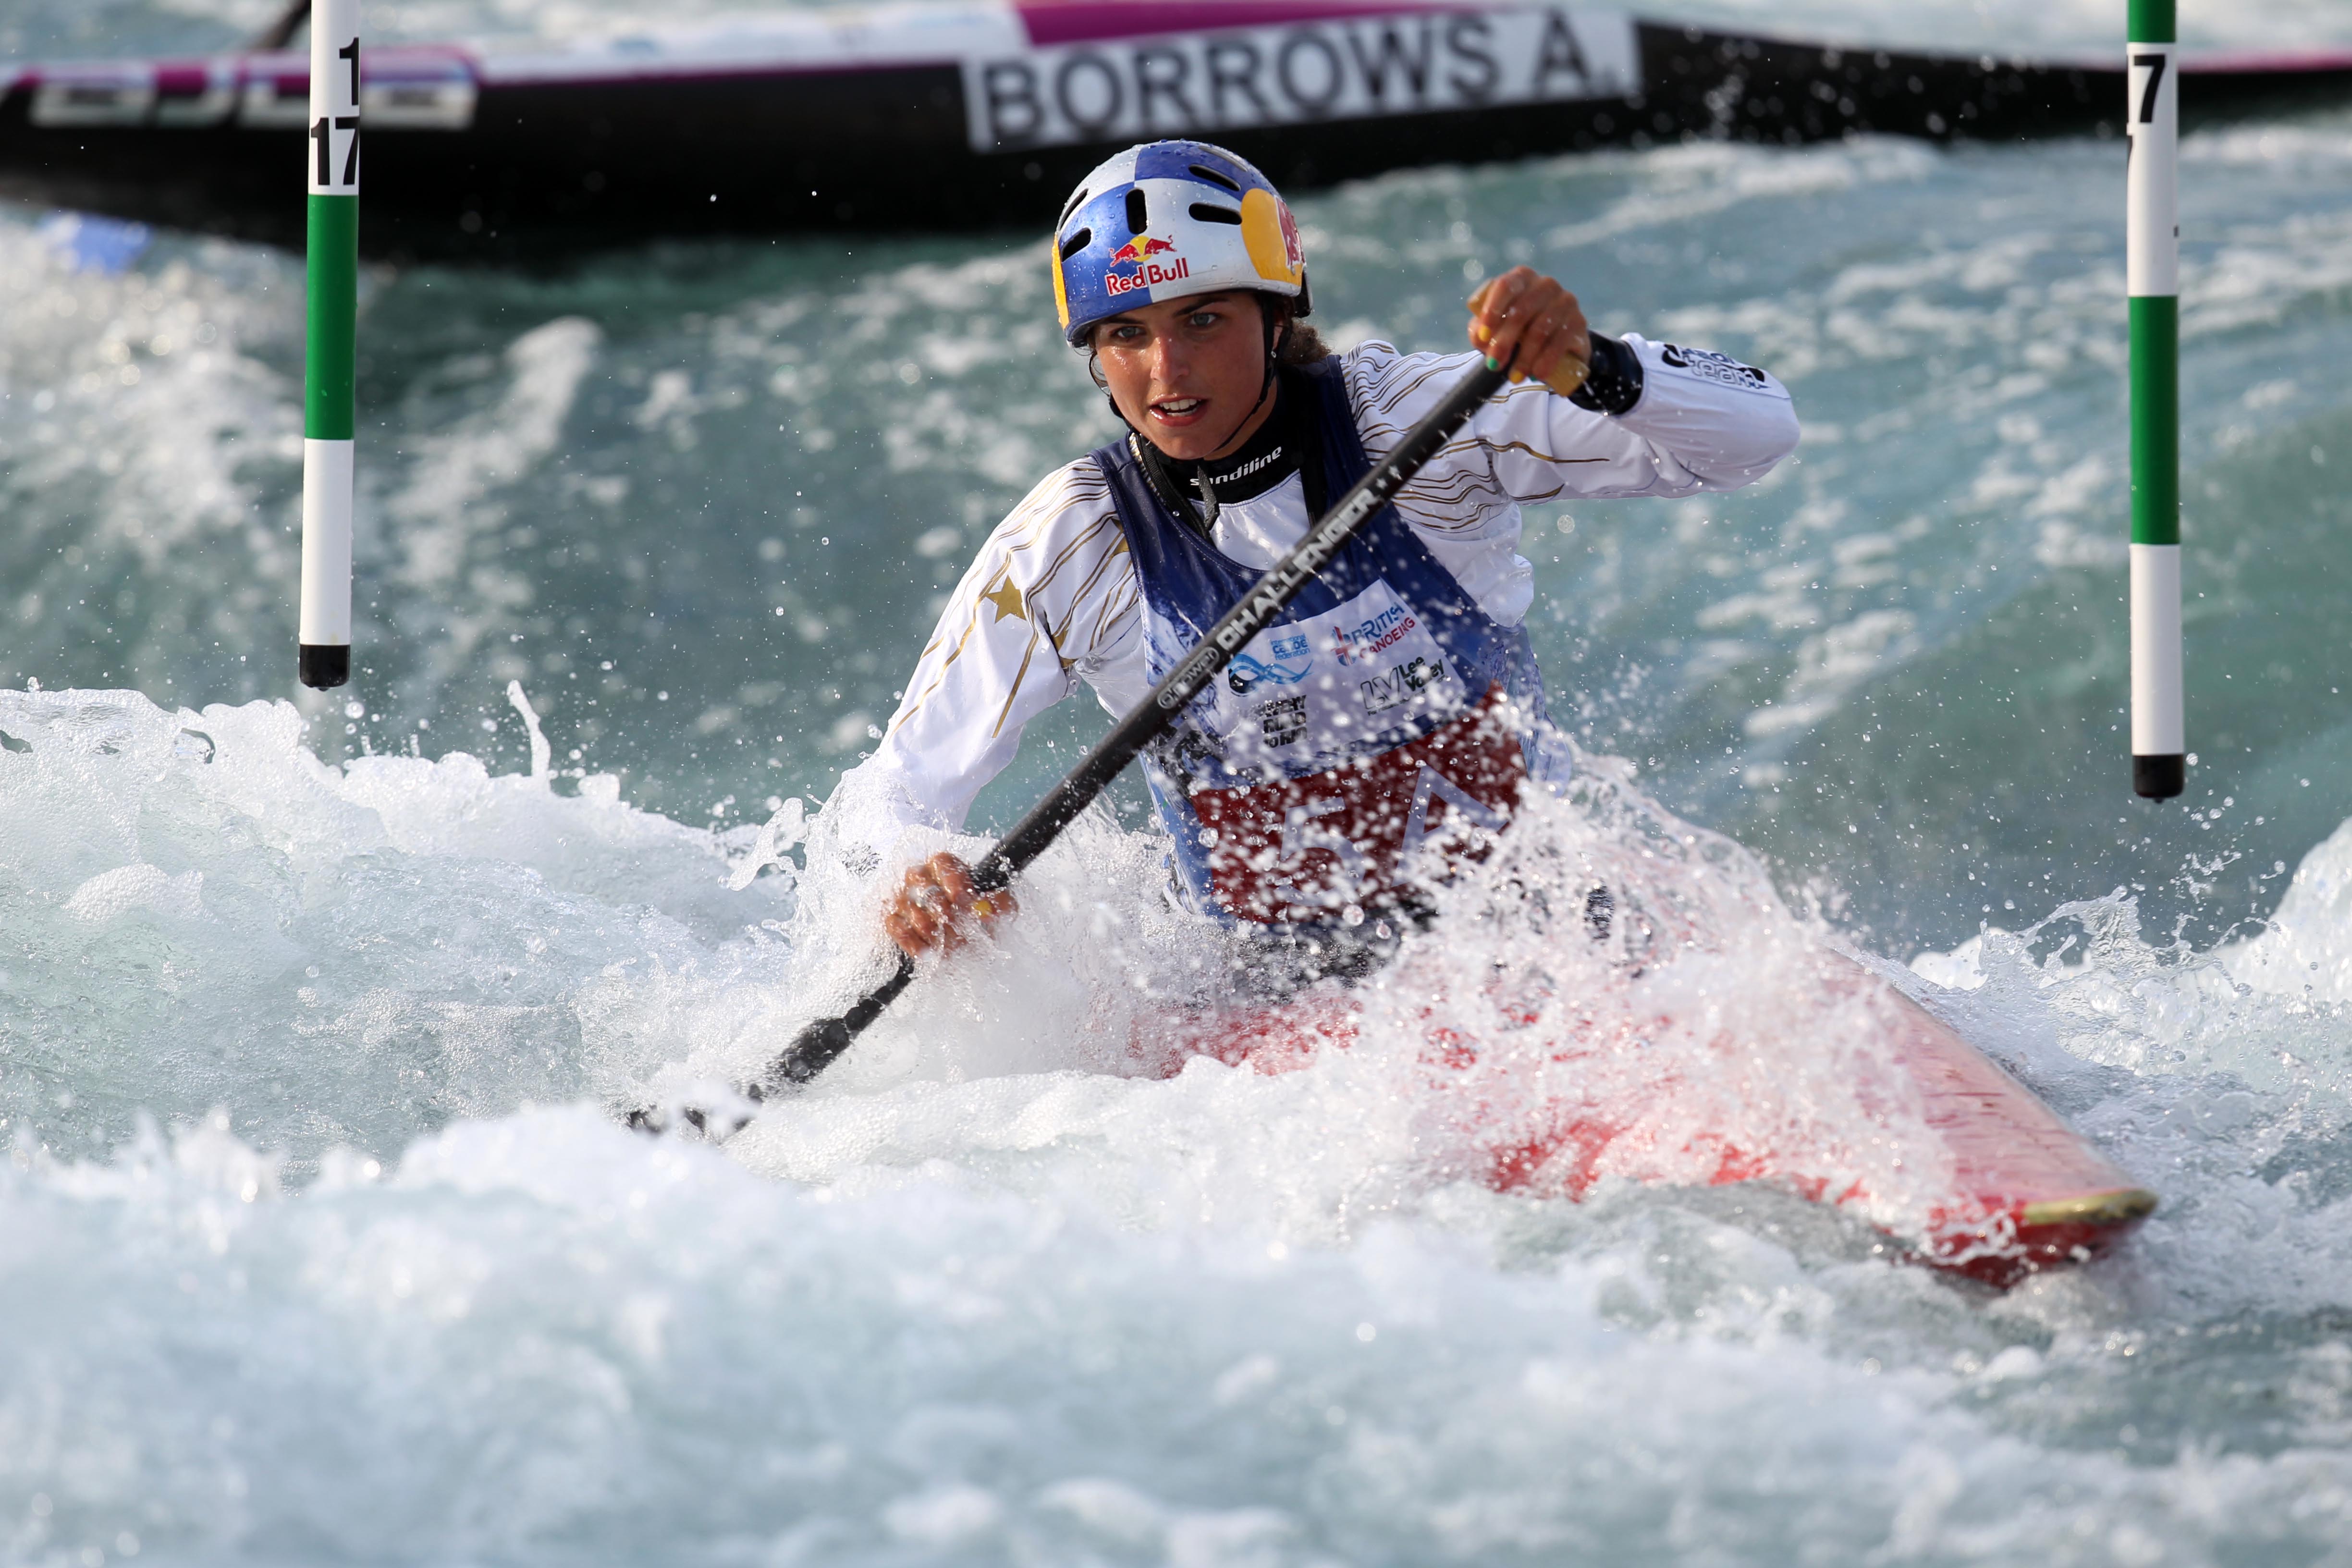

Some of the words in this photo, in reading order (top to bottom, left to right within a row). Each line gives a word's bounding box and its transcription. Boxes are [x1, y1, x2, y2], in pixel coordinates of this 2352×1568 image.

[981, 15, 1500, 145] BORROWS
[1533, 9, 1591, 95] A
[311, 117, 359, 185] 17
[1106, 265, 1148, 296] Red
[1148, 257, 1189, 285] Bull
[1190, 446, 1282, 486] sndiline
[1216, 488, 1379, 651] CHALLENGER
[1271, 633, 1306, 645] intertional
[1398, 657, 1425, 679] Lee
[1405, 659, 1445, 691] Vaey
